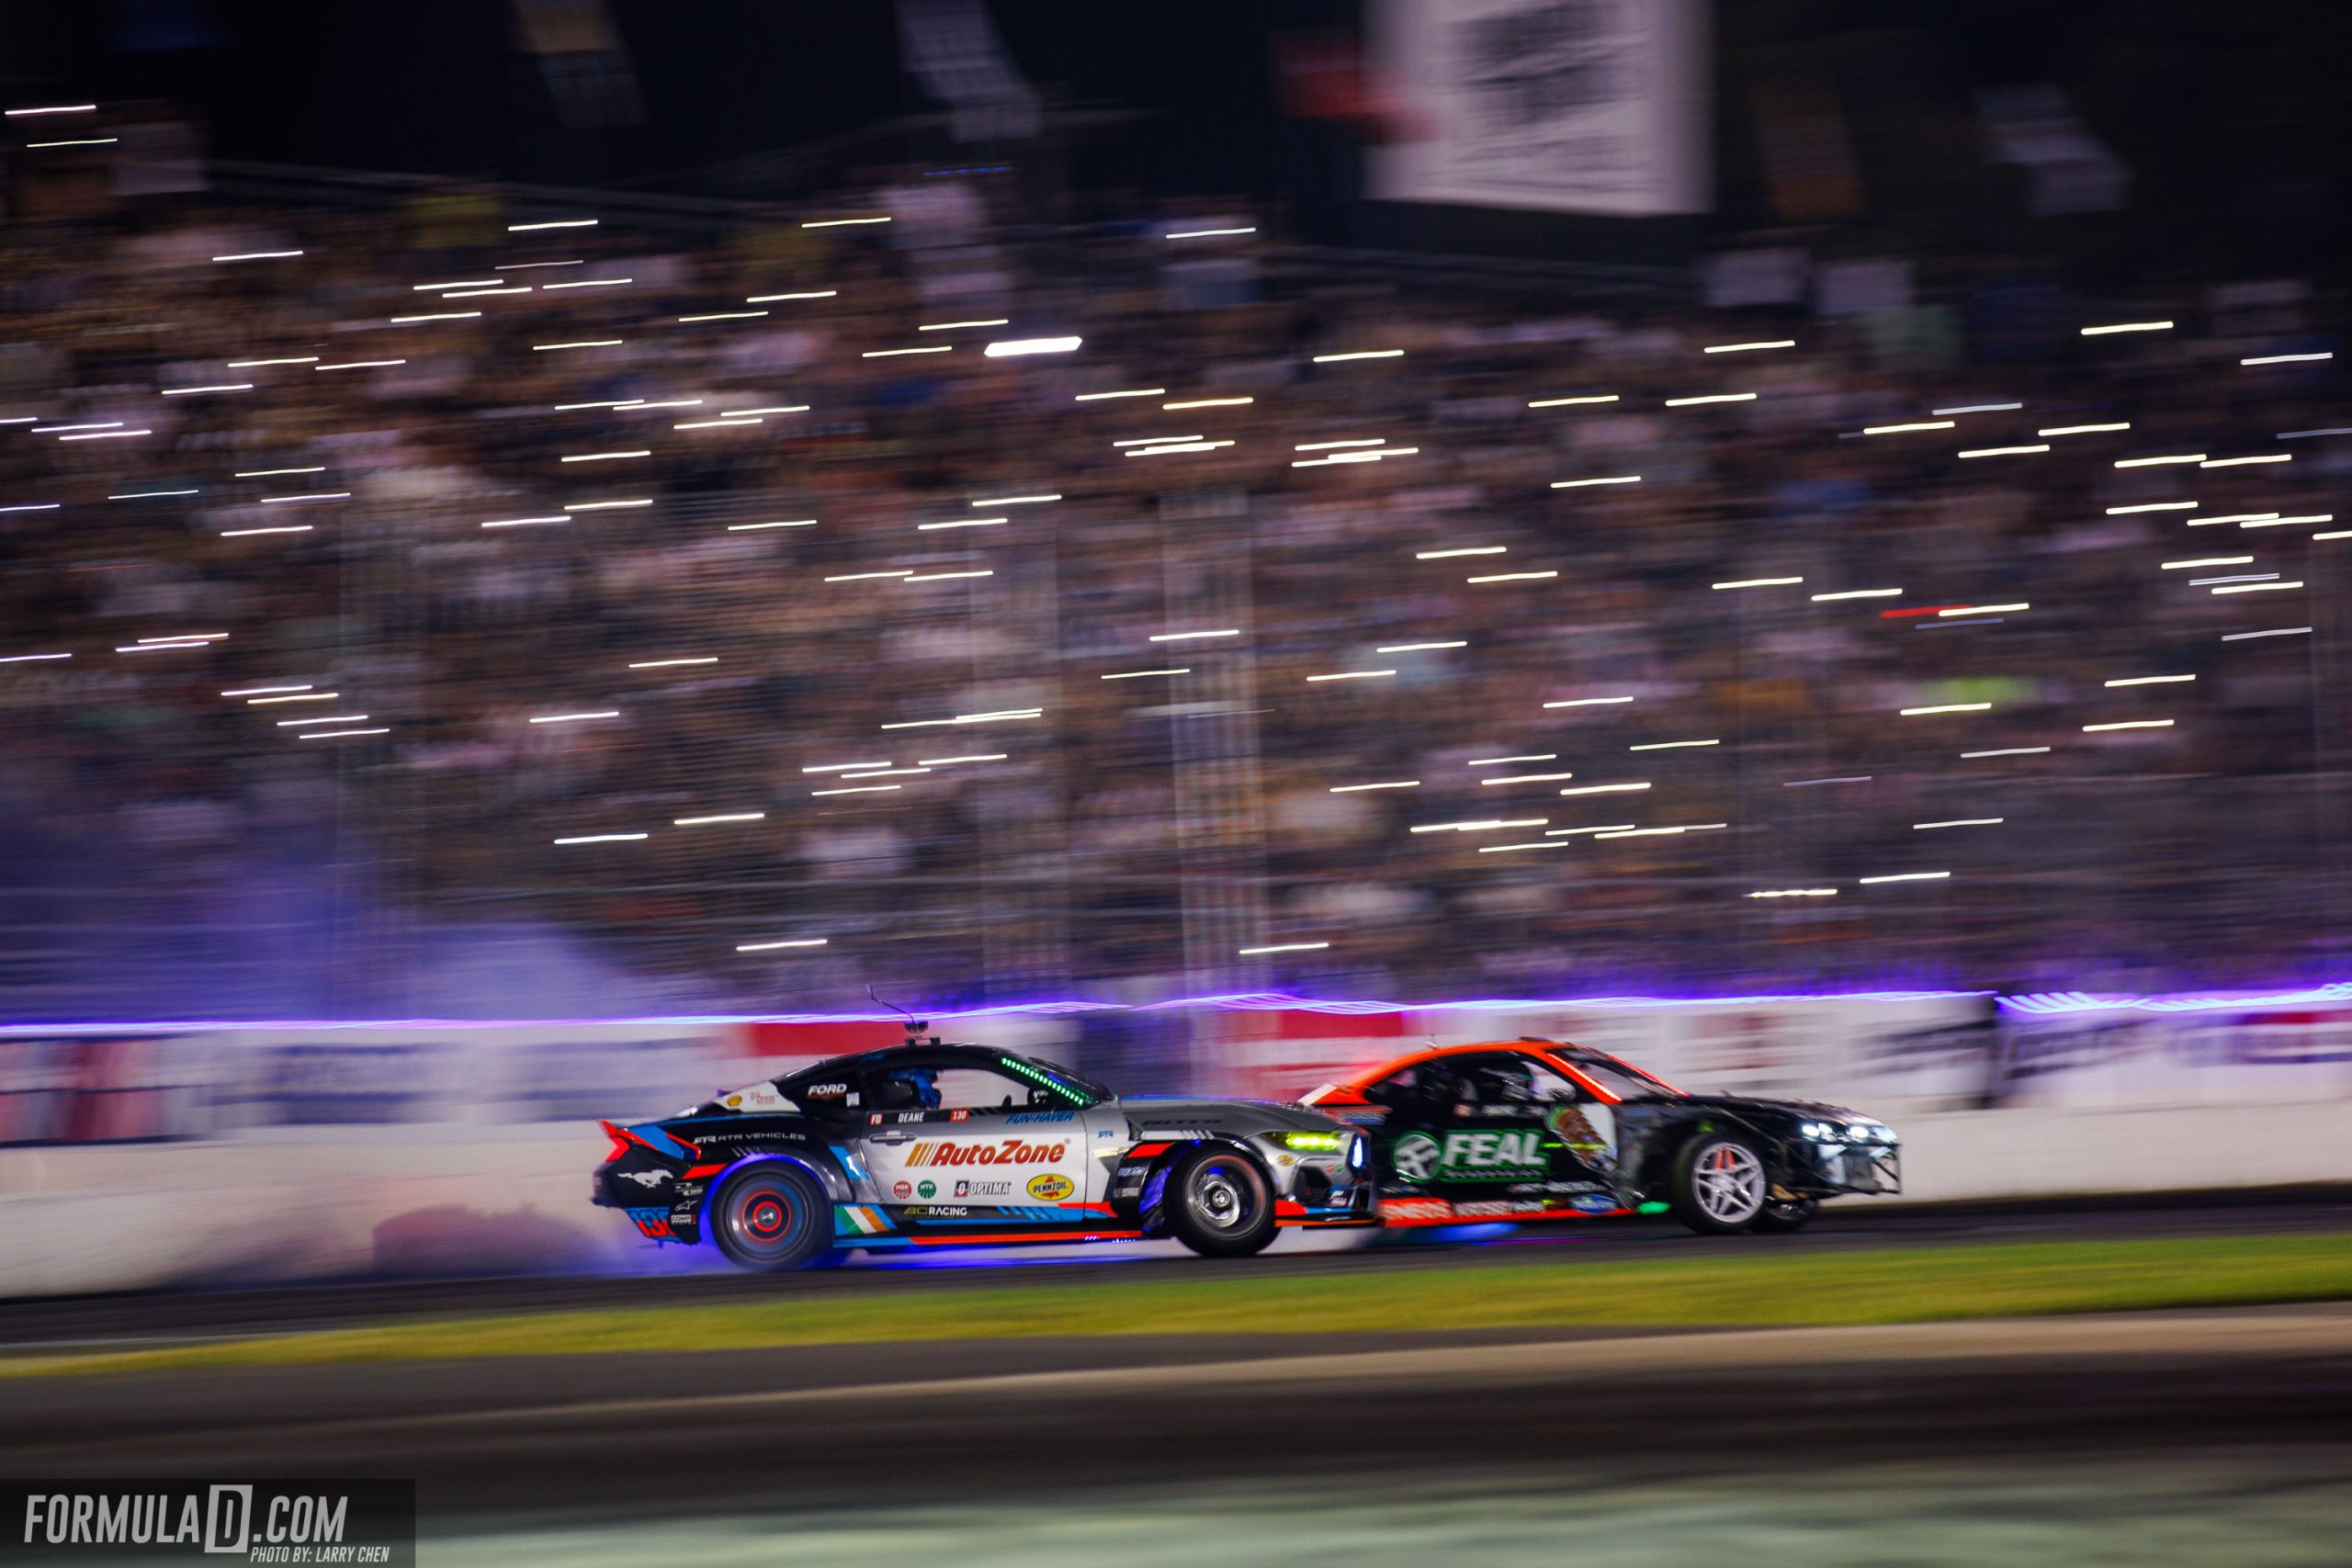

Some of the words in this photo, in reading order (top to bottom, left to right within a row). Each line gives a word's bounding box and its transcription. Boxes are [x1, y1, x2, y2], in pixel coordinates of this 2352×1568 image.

[808, 1083, 847, 1096] FORD
[870, 1113, 882, 1125] FD
[898, 1111, 925, 1123] DEANE
[952, 1110, 967, 1121] 130
[745, 1132, 806, 1141] VEHICLES
[930, 1139, 1066, 1167] AutoZone
[1442, 1131, 1547, 1167] FEAL
[969, 1181, 1011, 1195] OPTIMA
[1033, 1181, 1068, 1194] PENNZOIL
[929, 1206, 968, 1216] RACING
